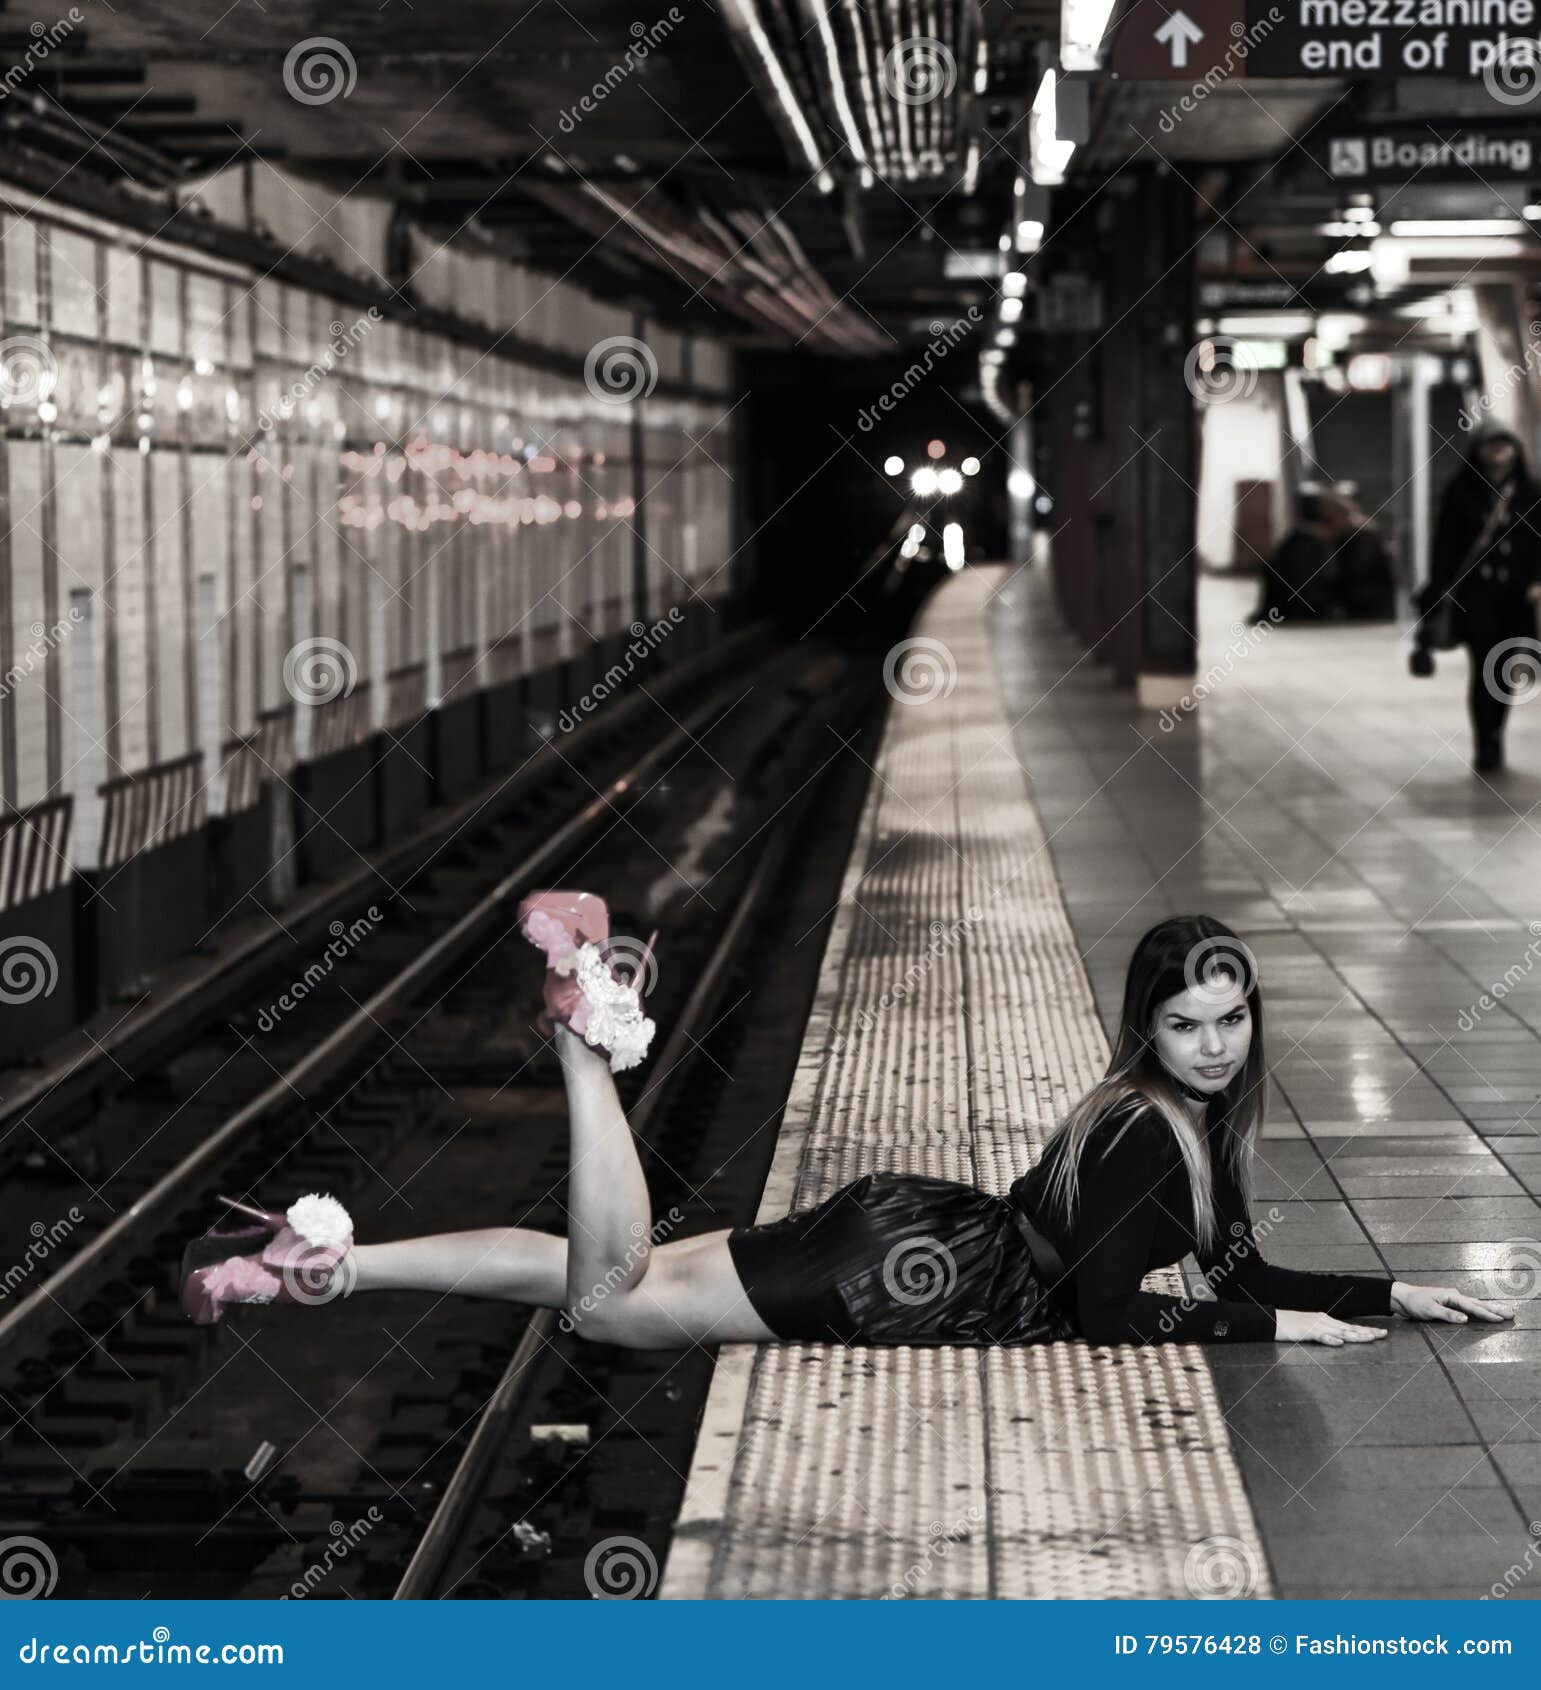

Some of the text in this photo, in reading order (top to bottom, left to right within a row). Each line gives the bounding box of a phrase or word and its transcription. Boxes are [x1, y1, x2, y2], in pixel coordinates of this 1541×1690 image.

[1300, 0, 1535, 26] mezzanine
[1300, 31, 1541, 76] end of pla
[1371, 136, 1532, 170] Boarding
